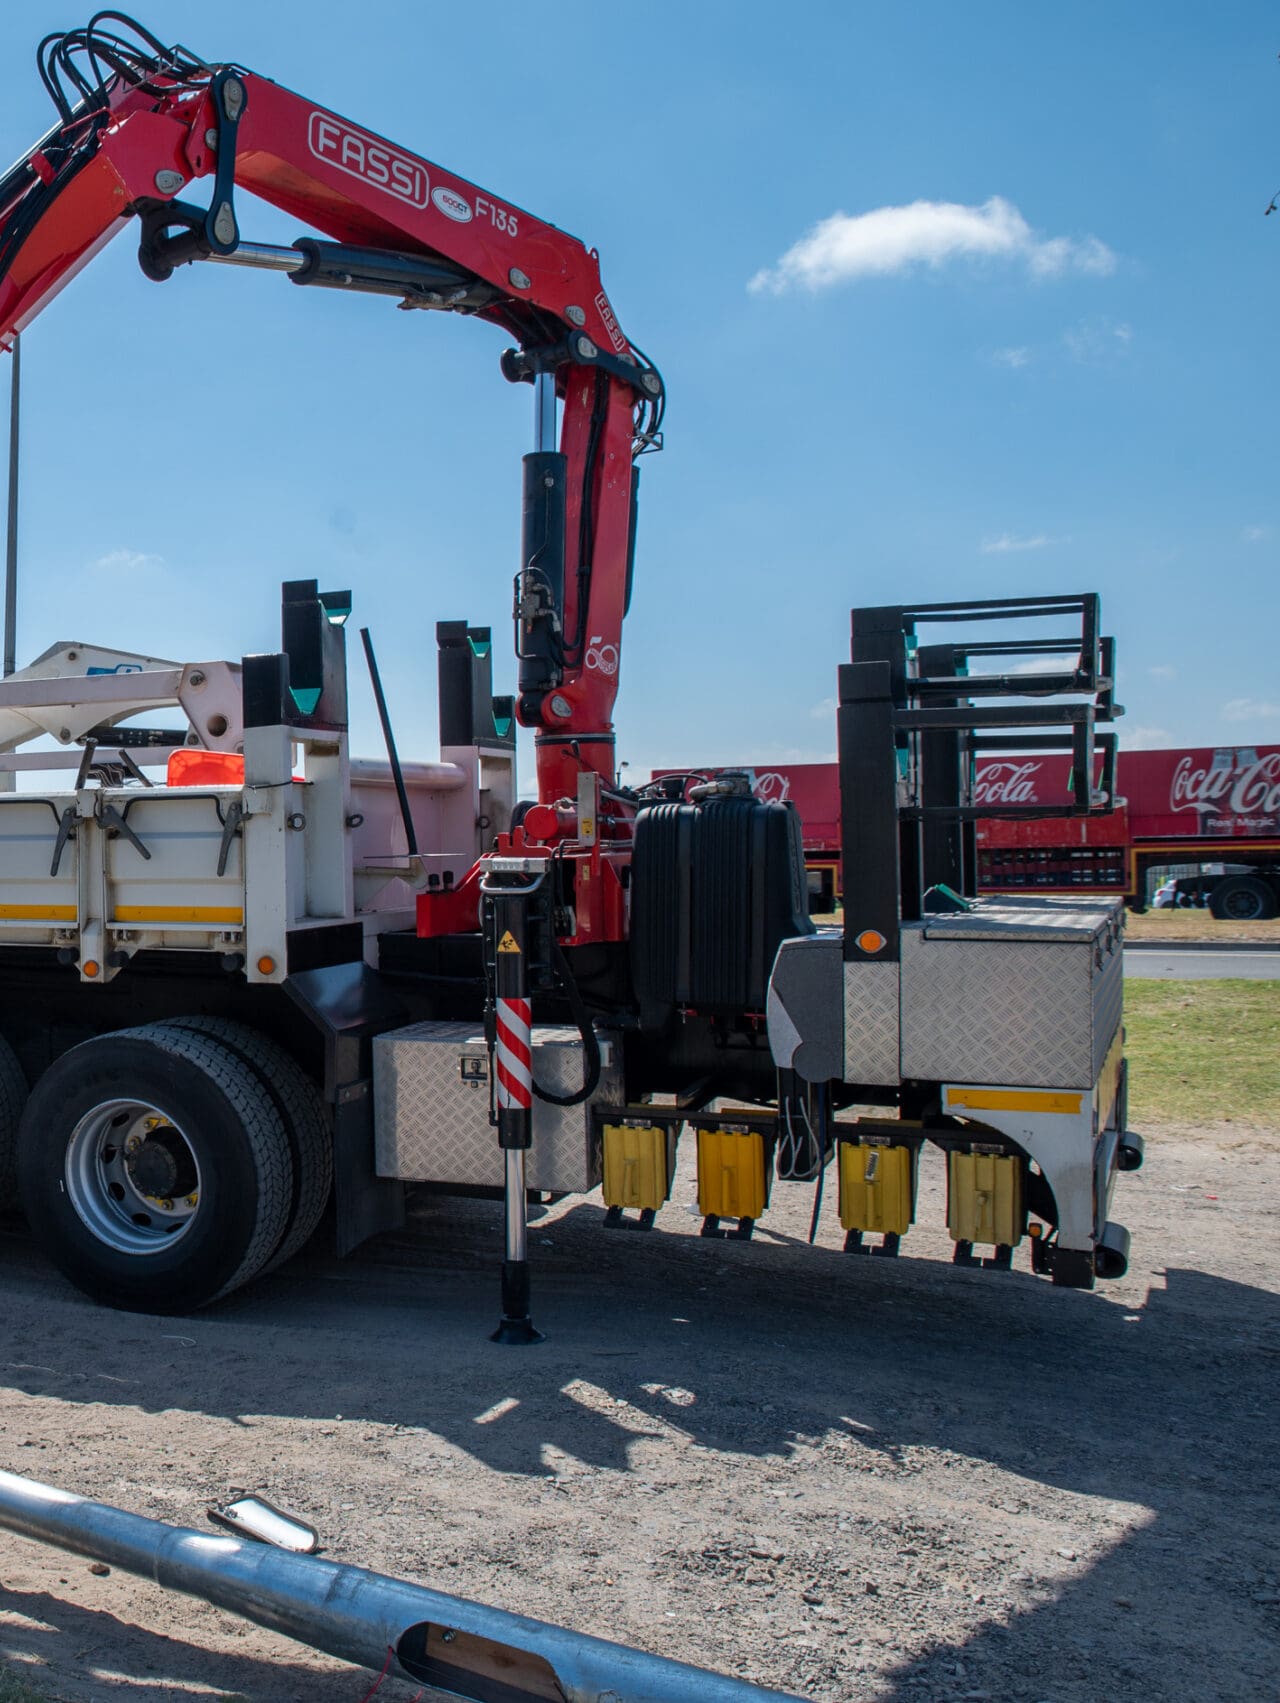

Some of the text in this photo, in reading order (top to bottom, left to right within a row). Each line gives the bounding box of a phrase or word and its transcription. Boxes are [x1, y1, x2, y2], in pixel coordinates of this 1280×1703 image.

[318, 120, 420, 201] FASSI
[475, 196, 518, 237] F135
[598, 297, 623, 346] FASSI
[1169, 753, 1280, 813] Coca-Co
